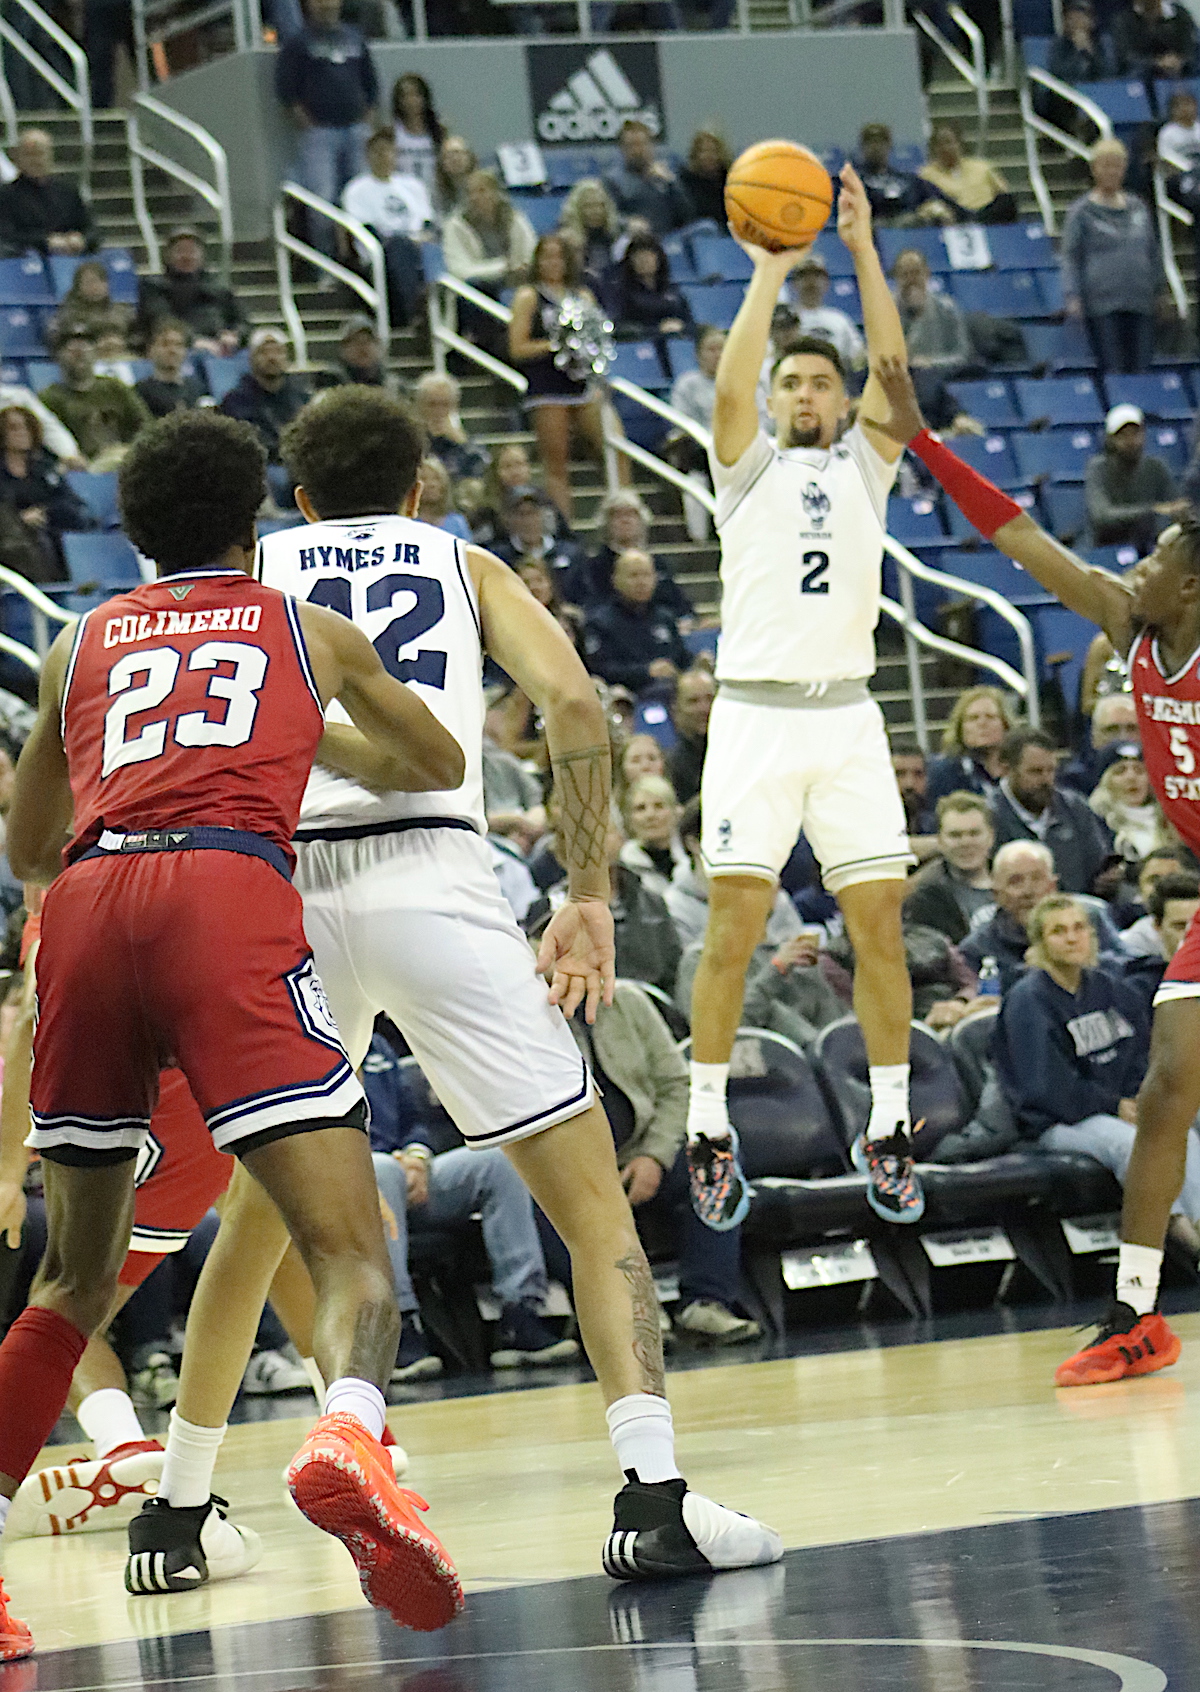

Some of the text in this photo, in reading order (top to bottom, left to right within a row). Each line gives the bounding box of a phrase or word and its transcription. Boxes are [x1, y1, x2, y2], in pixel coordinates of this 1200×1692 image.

[299, 543, 420, 572] HYMES JR
[801, 551, 829, 593] 2
[104, 605, 262, 649] COLIMERIO
[101, 641, 270, 780] 23
[1169, 726, 1195, 774] 5
